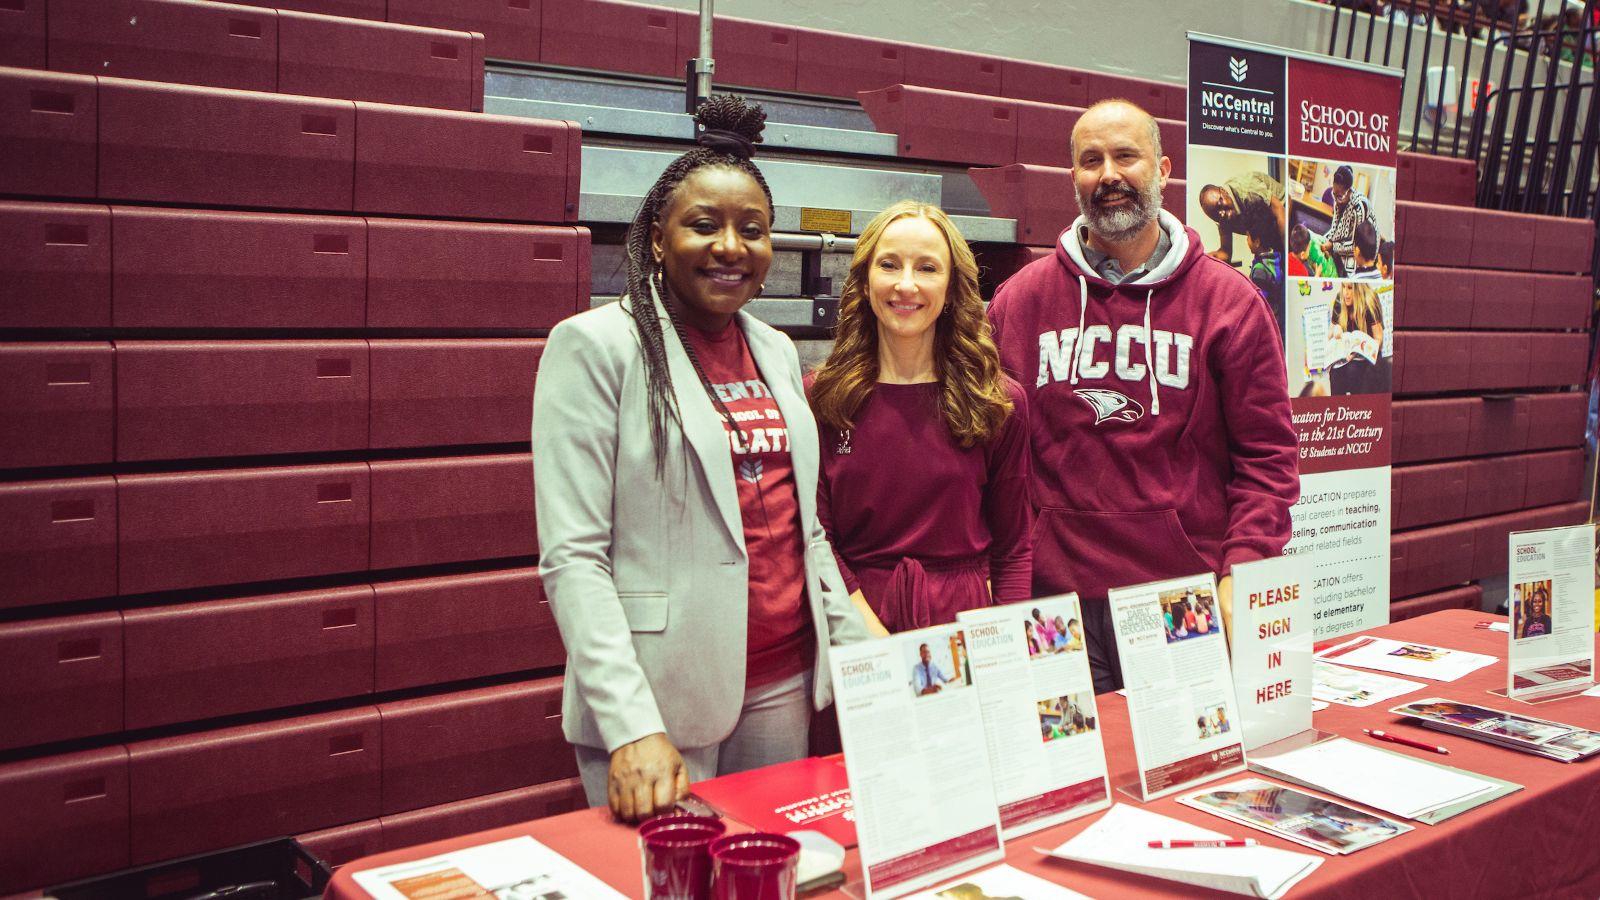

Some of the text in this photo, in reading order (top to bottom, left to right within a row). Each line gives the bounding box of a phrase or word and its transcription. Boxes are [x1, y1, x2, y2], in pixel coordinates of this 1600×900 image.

[1202, 91, 1274, 116] NCCentral
[1202, 108, 1274, 125] UNIVERSITY
[1301, 100, 1389, 133] SCHOOL OF
[1202, 122, 1224, 131] Discover
[1225, 125, 1240, 134] what's
[1241, 127, 1258, 135] Central
[1301, 121, 1390, 153] EDUCATION
[1036, 324, 1194, 390] NCCU
[1291, 406, 1373, 427] ucators for Diverse
[1300, 424, 1383, 442] in the 21st Century
[1309, 445, 1336, 458] Students
[1337, 446, 1345, 456] at
[1345, 442, 1373, 455] NCCU
[1343, 489, 1376, 501] prepares
[1308, 508, 1336, 521] careers
[1337, 506, 1344, 516] in
[1345, 503, 1381, 515] teaching,
[1292, 519, 1377, 539] seling, communication
[1299, 542, 1314, 553] and
[1316, 540, 1341, 552] related
[1342, 535, 1362, 547] fields
[1342, 572, 1363, 584] offers
[1249, 583, 1300, 610] PLEASE
[1344, 584, 1376, 599] bachelor
[1323, 603, 1364, 619] elementary
[970, 625, 1000, 640] SCHOOL
[1258, 617, 1291, 640] SIGN
[1325, 619, 1354, 633] degrees
[1356, 617, 1363, 626] in
[841, 660, 874, 677] SCHOOL
[1268, 651, 1282, 670] IN
[1256, 680, 1292, 705] HERE
